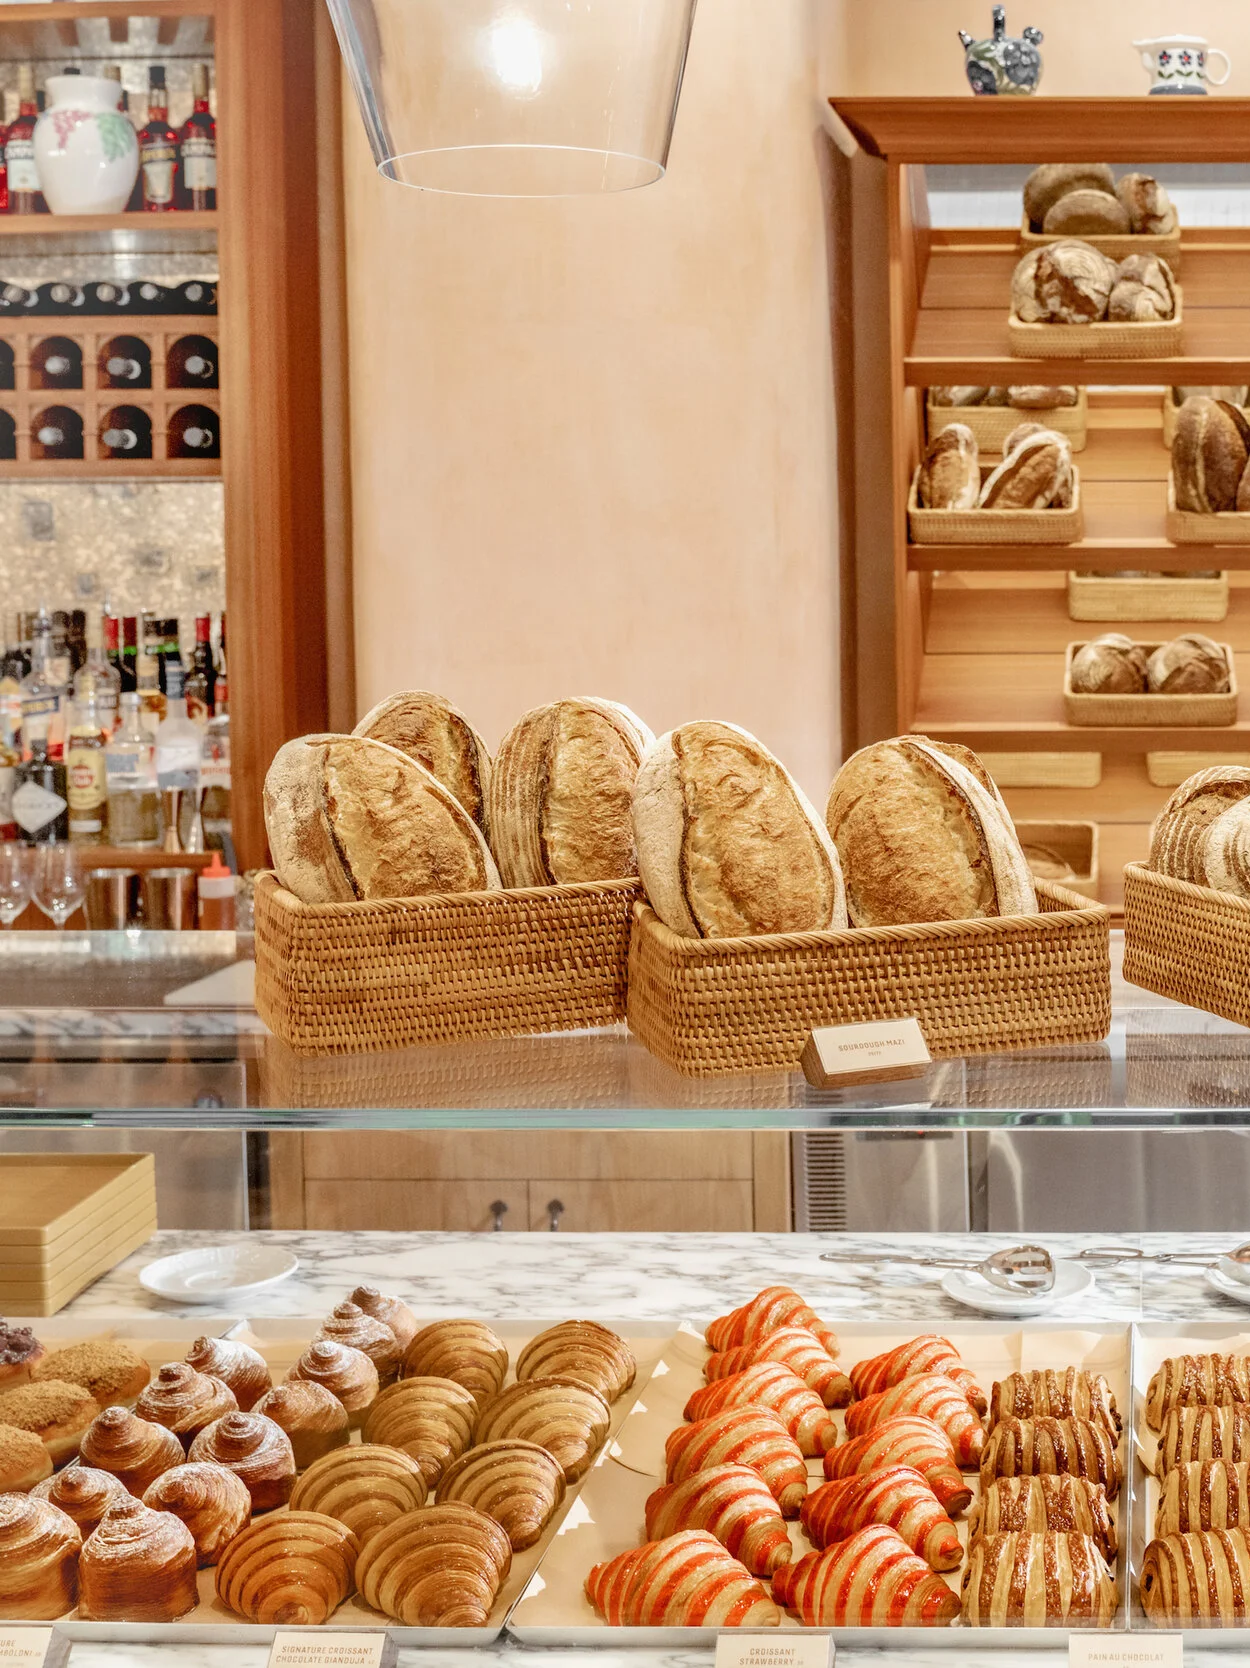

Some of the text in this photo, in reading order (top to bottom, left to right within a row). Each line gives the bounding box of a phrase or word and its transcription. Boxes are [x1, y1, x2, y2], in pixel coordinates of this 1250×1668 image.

[838, 1041, 885, 1052] SOURDOUGH
[282, 1645, 373, 1655] SIGNATURE CROISSANT
[749, 1648, 795, 1656] CROISSANT
[276, 1655, 321, 1663] CHOCOLATE
[324, 1656, 365, 1664] GIANDUJA
[1088, 1653, 1164, 1661] PAIN AU CHOCOLAT
[739, 1658, 793, 1666] STRAWBERRY
